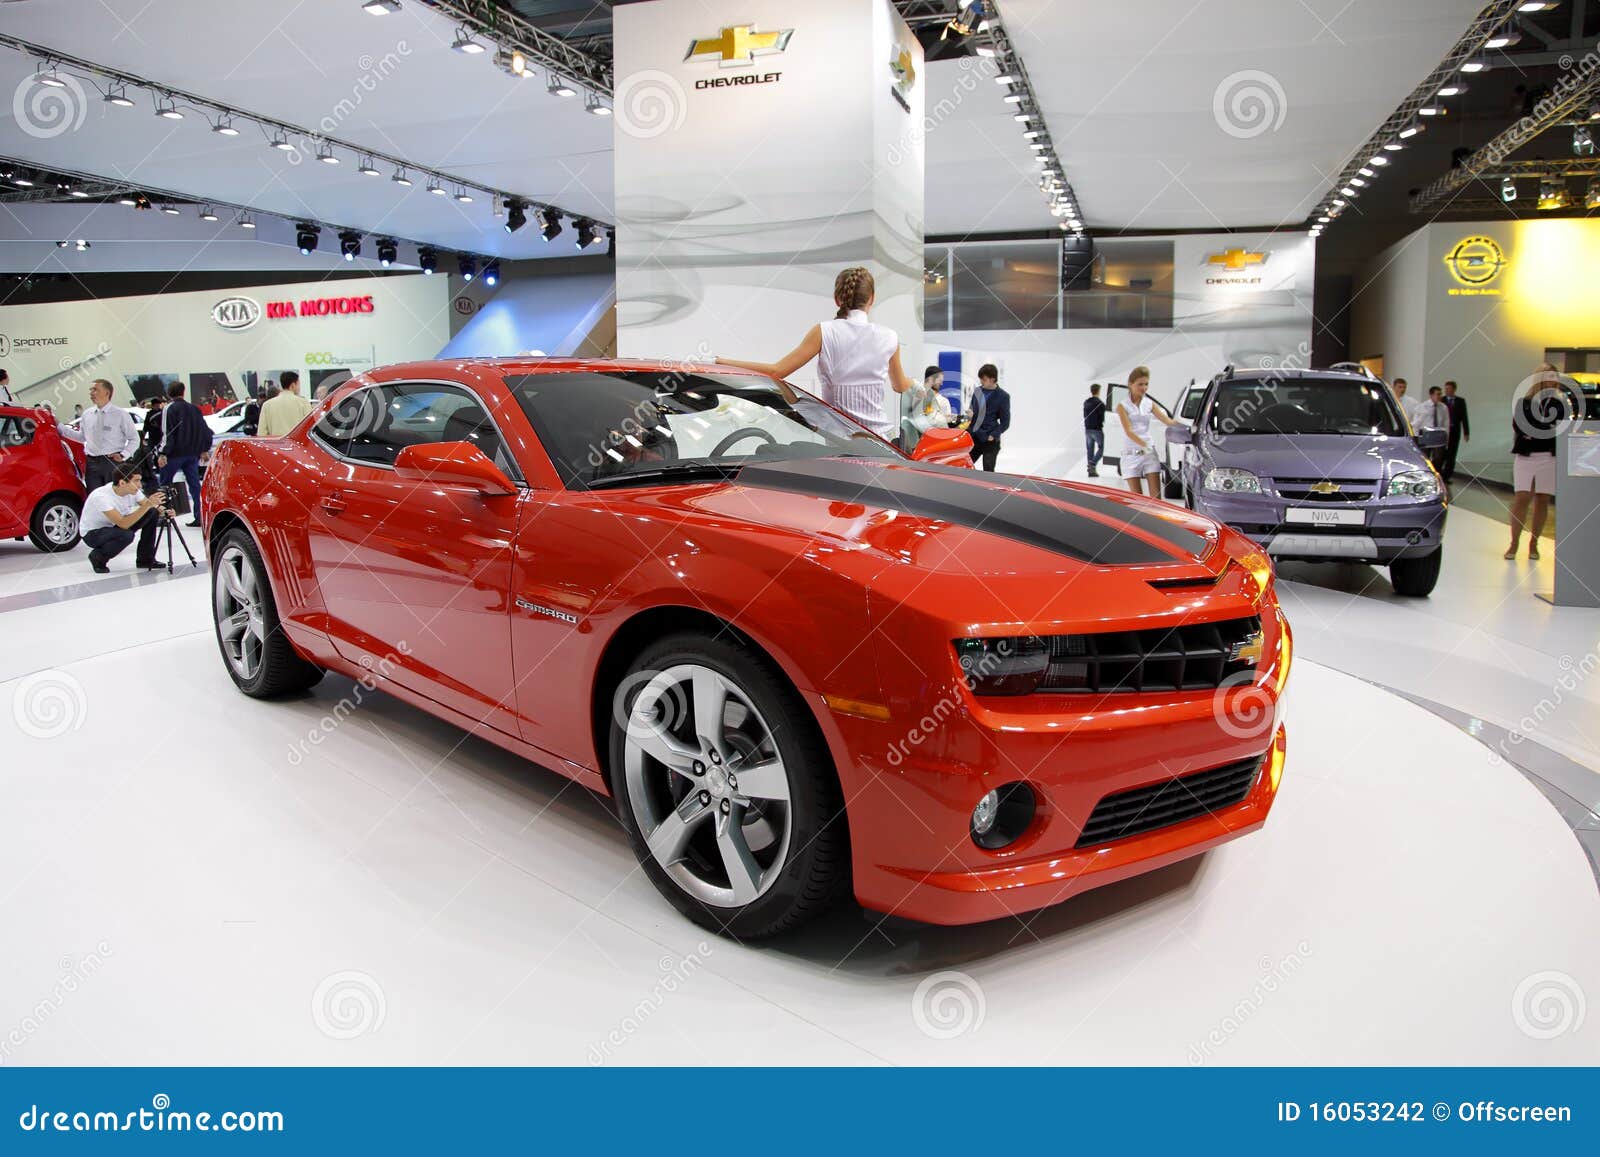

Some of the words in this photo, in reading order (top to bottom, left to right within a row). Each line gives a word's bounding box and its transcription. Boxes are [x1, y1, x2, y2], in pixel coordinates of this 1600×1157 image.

[695, 72, 782, 90] CHEVROLET
[266, 302, 296, 319] KIA
[299, 295, 375, 317] MOTORS
[13, 337, 69, 347] SPORTAGE
[1311, 511, 1340, 521] NIVA
[515, 599, 577, 624] CAMARO
